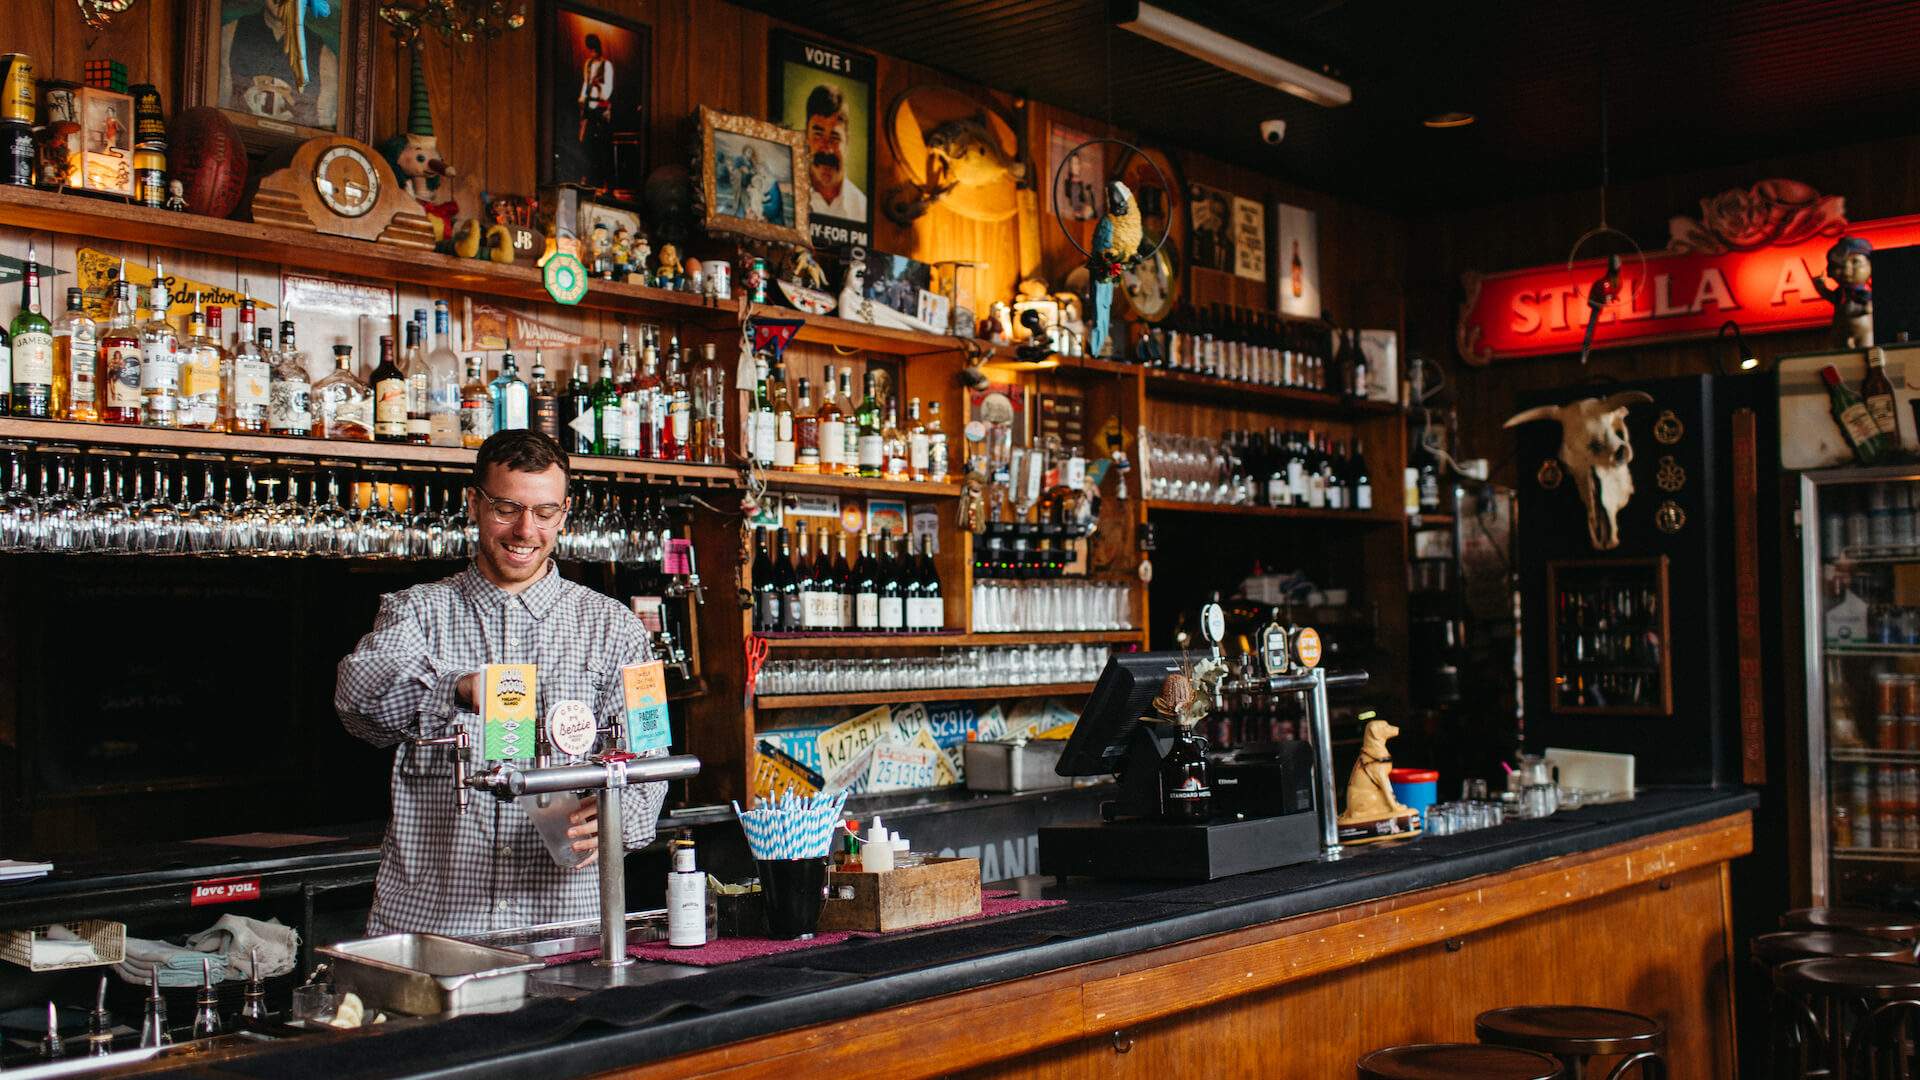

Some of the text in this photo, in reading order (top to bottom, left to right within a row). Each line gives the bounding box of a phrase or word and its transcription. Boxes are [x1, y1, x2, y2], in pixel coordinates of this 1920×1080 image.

[804, 46, 851, 73] VOTE 1
[850, 230, 868, 247] PM
[1511, 268, 1741, 334] STELLA
[560, 719, 591, 736] Bertie
[196, 883, 257, 897] love you.
